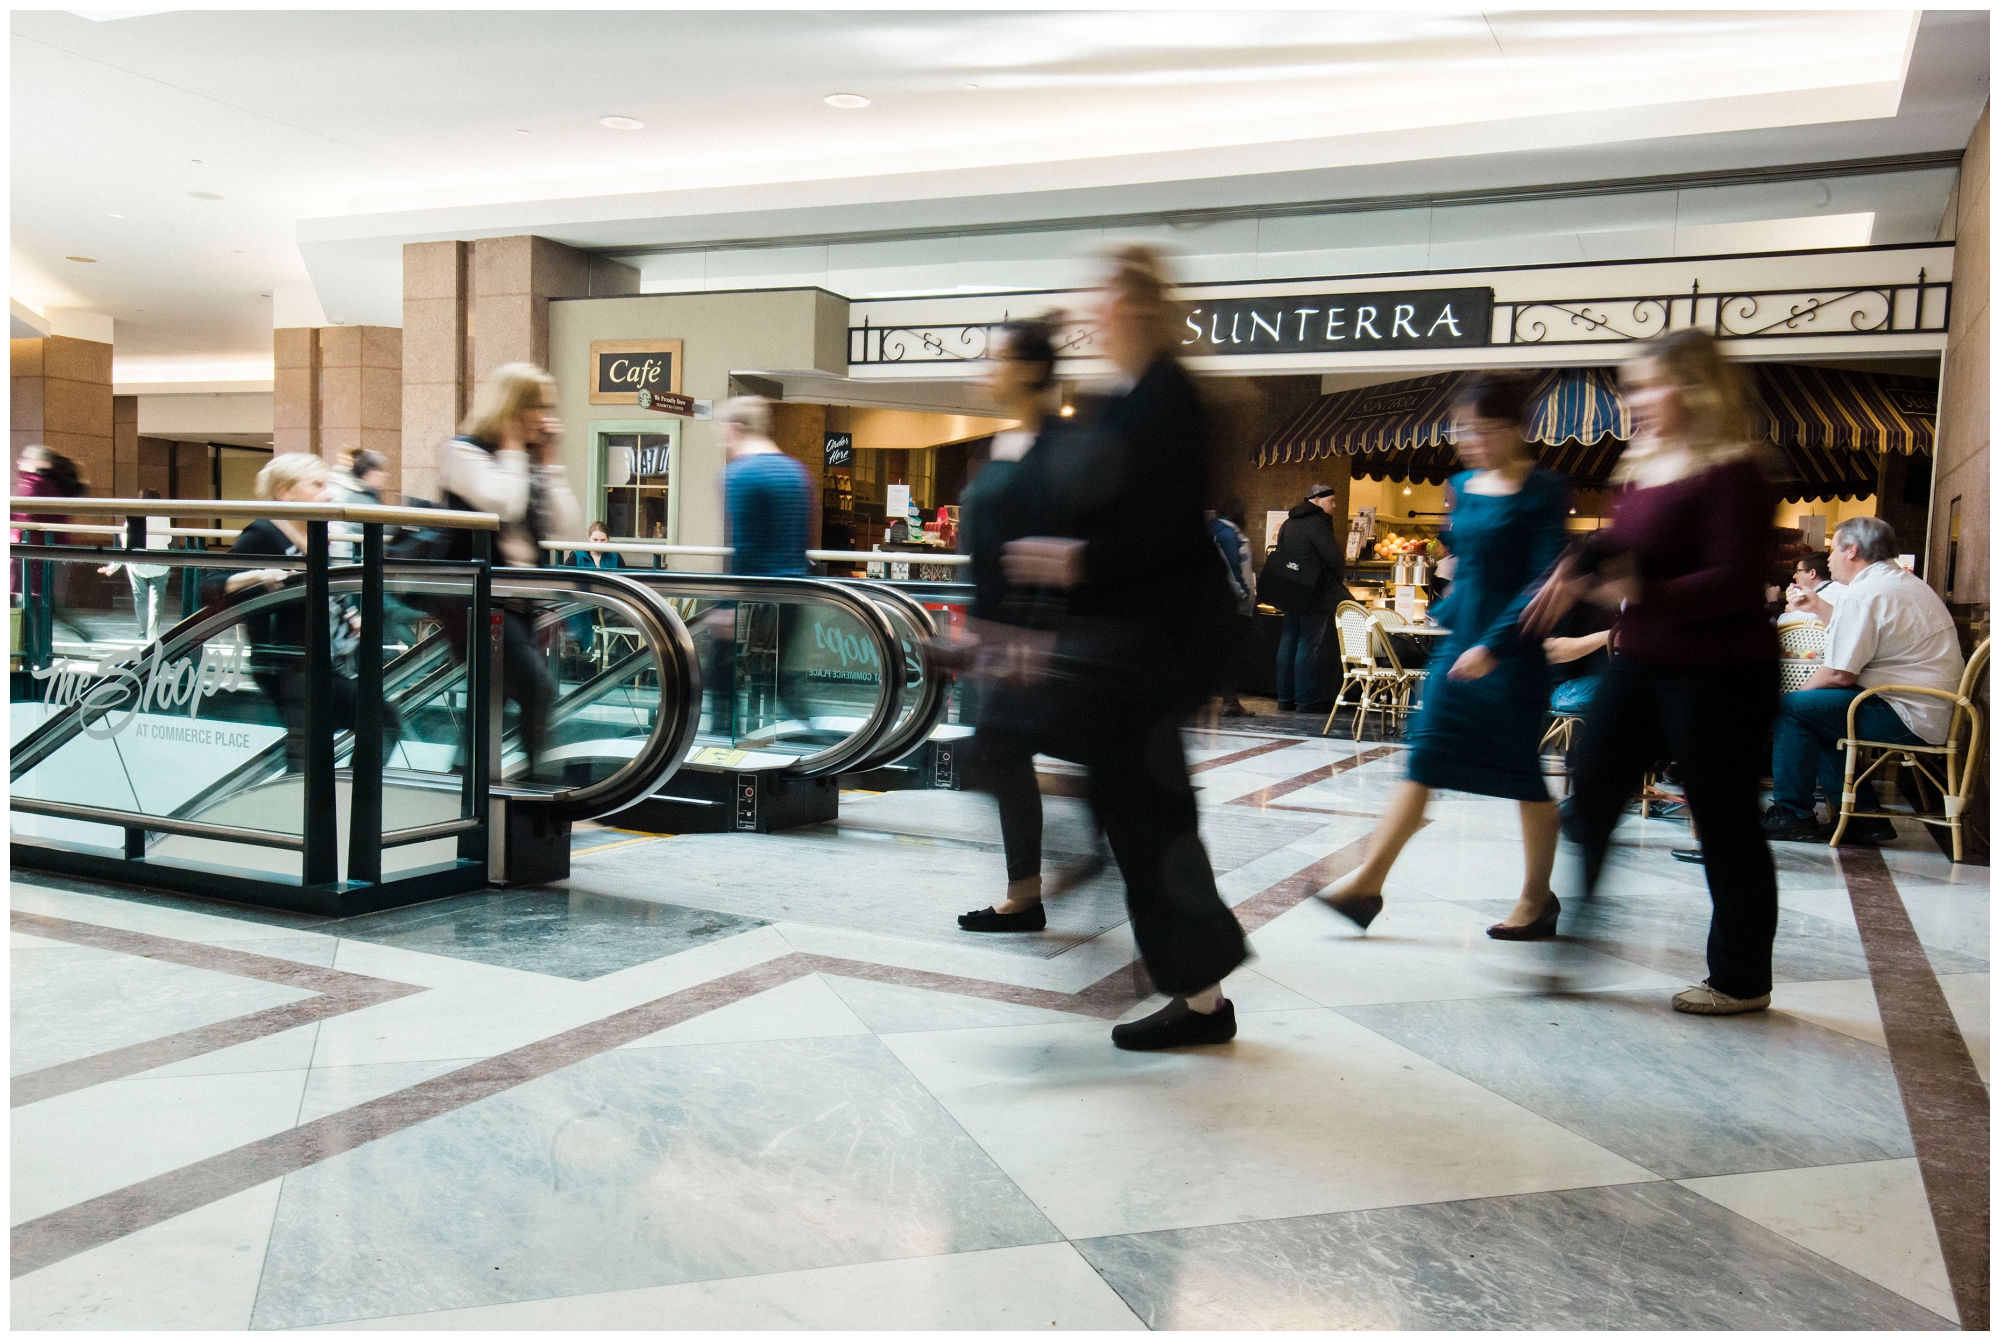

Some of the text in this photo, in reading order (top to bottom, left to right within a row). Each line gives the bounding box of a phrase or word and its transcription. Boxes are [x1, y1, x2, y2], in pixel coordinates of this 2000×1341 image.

[1181, 302, 1463, 345] SUNTERRA
[609, 359, 662, 388] Café
[826, 436, 849, 453] Order
[828, 449, 850, 465] Here
[31, 638, 244, 740] The Shops
[135, 723, 250, 749] AT COMMERCE PLACE
